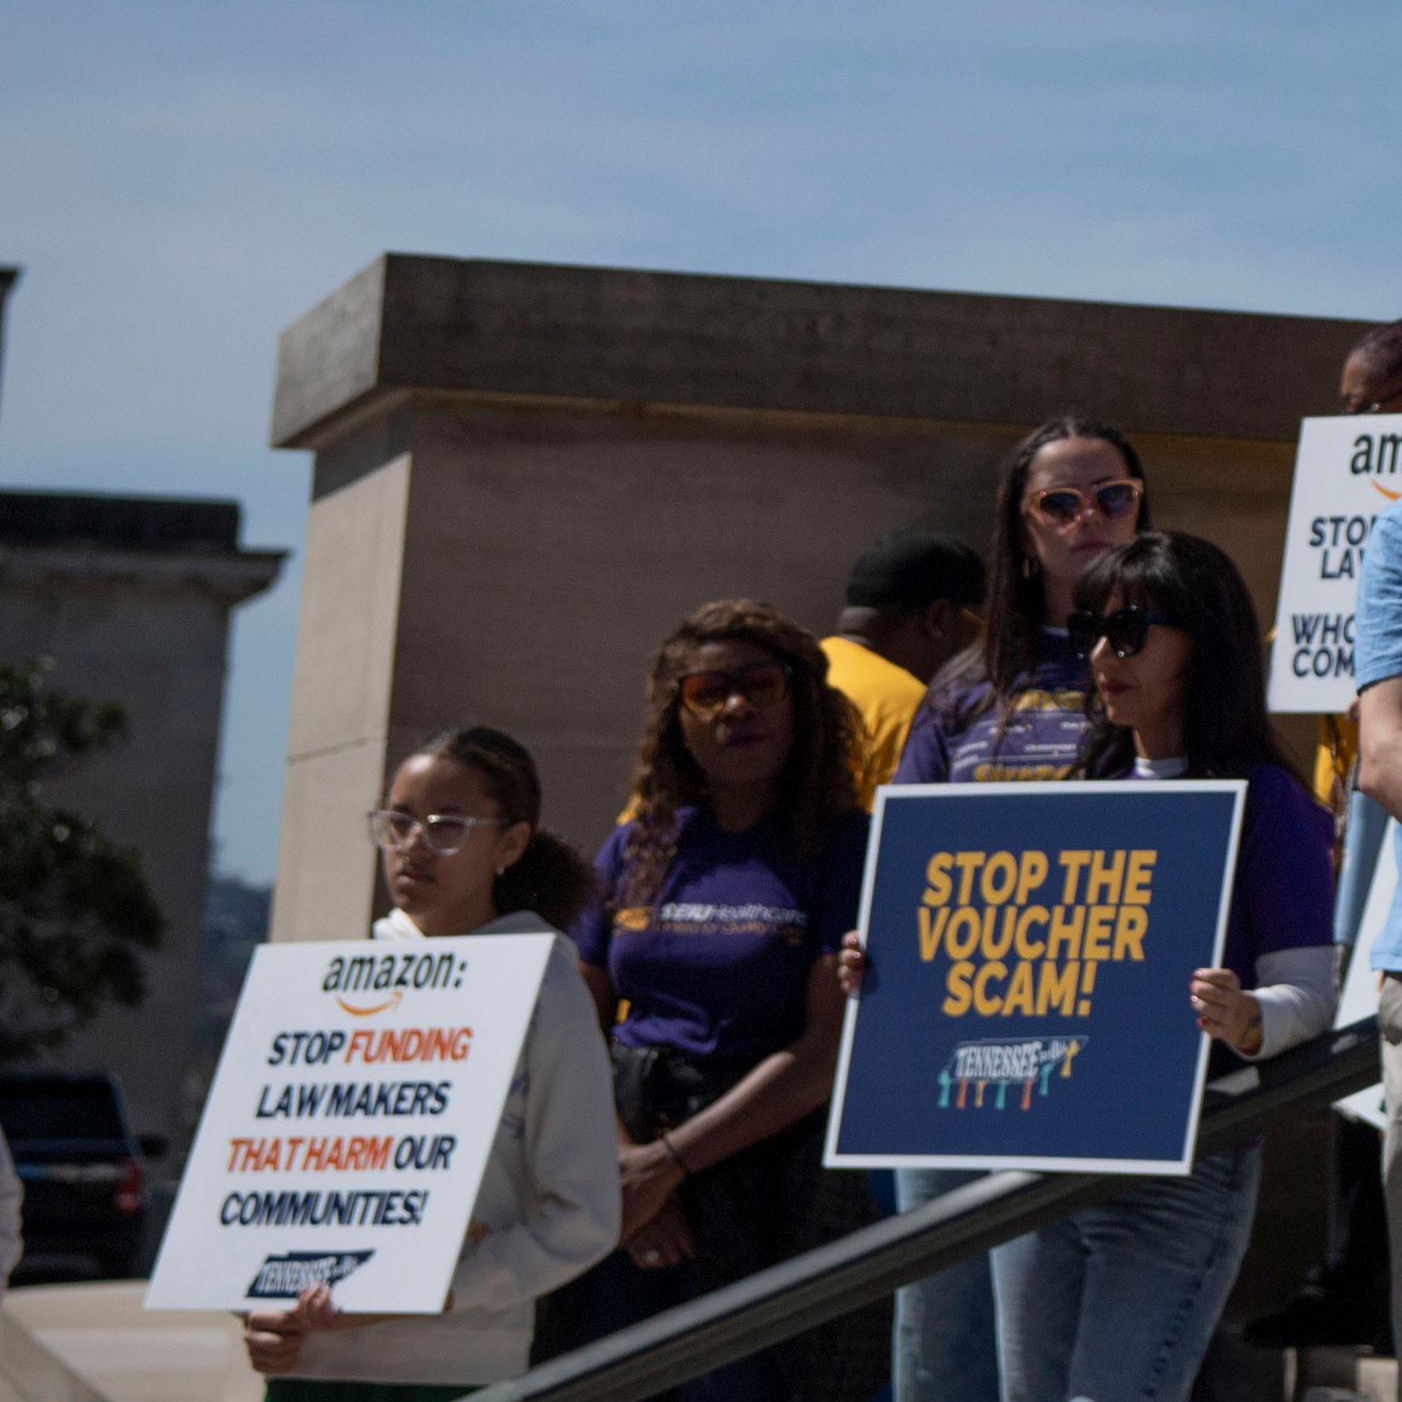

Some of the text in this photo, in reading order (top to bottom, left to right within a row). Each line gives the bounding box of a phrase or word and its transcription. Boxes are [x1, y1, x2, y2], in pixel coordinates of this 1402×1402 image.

[922, 849, 1158, 908] STOP THE
[917, 904, 1149, 963] VOUCHER
[322, 952, 467, 992] amazon:
[941, 959, 1098, 1018] SCAM!
[268, 1027, 473, 1066] STOP FUNDING
[954, 1040, 1043, 1079] TENNESSEE
[226, 1134, 457, 1173] THAT HARM OUR
[220, 1189, 430, 1227] COMMUNITIES!
